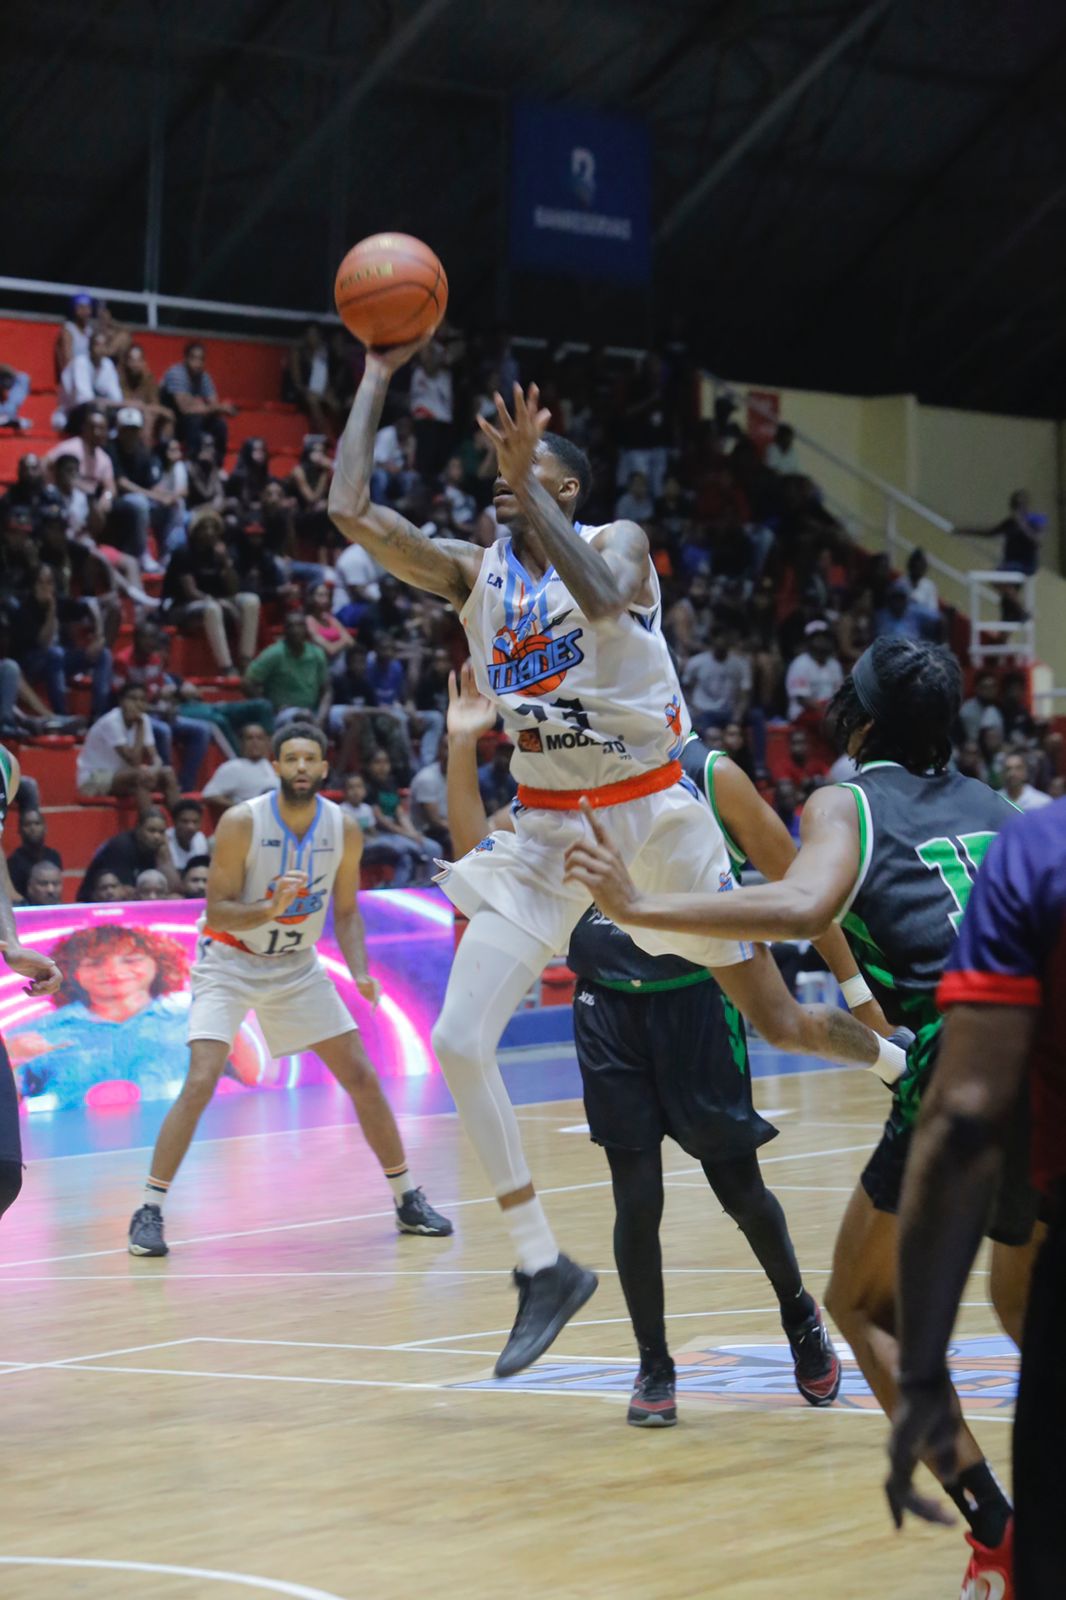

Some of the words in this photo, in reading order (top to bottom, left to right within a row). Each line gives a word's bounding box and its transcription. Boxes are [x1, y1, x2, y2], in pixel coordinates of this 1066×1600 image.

[487, 628, 584, 696] TITANES
[546, 731, 626, 754] MODTO
[915, 830, 999, 936] 1
[263, 929, 304, 955] 12
